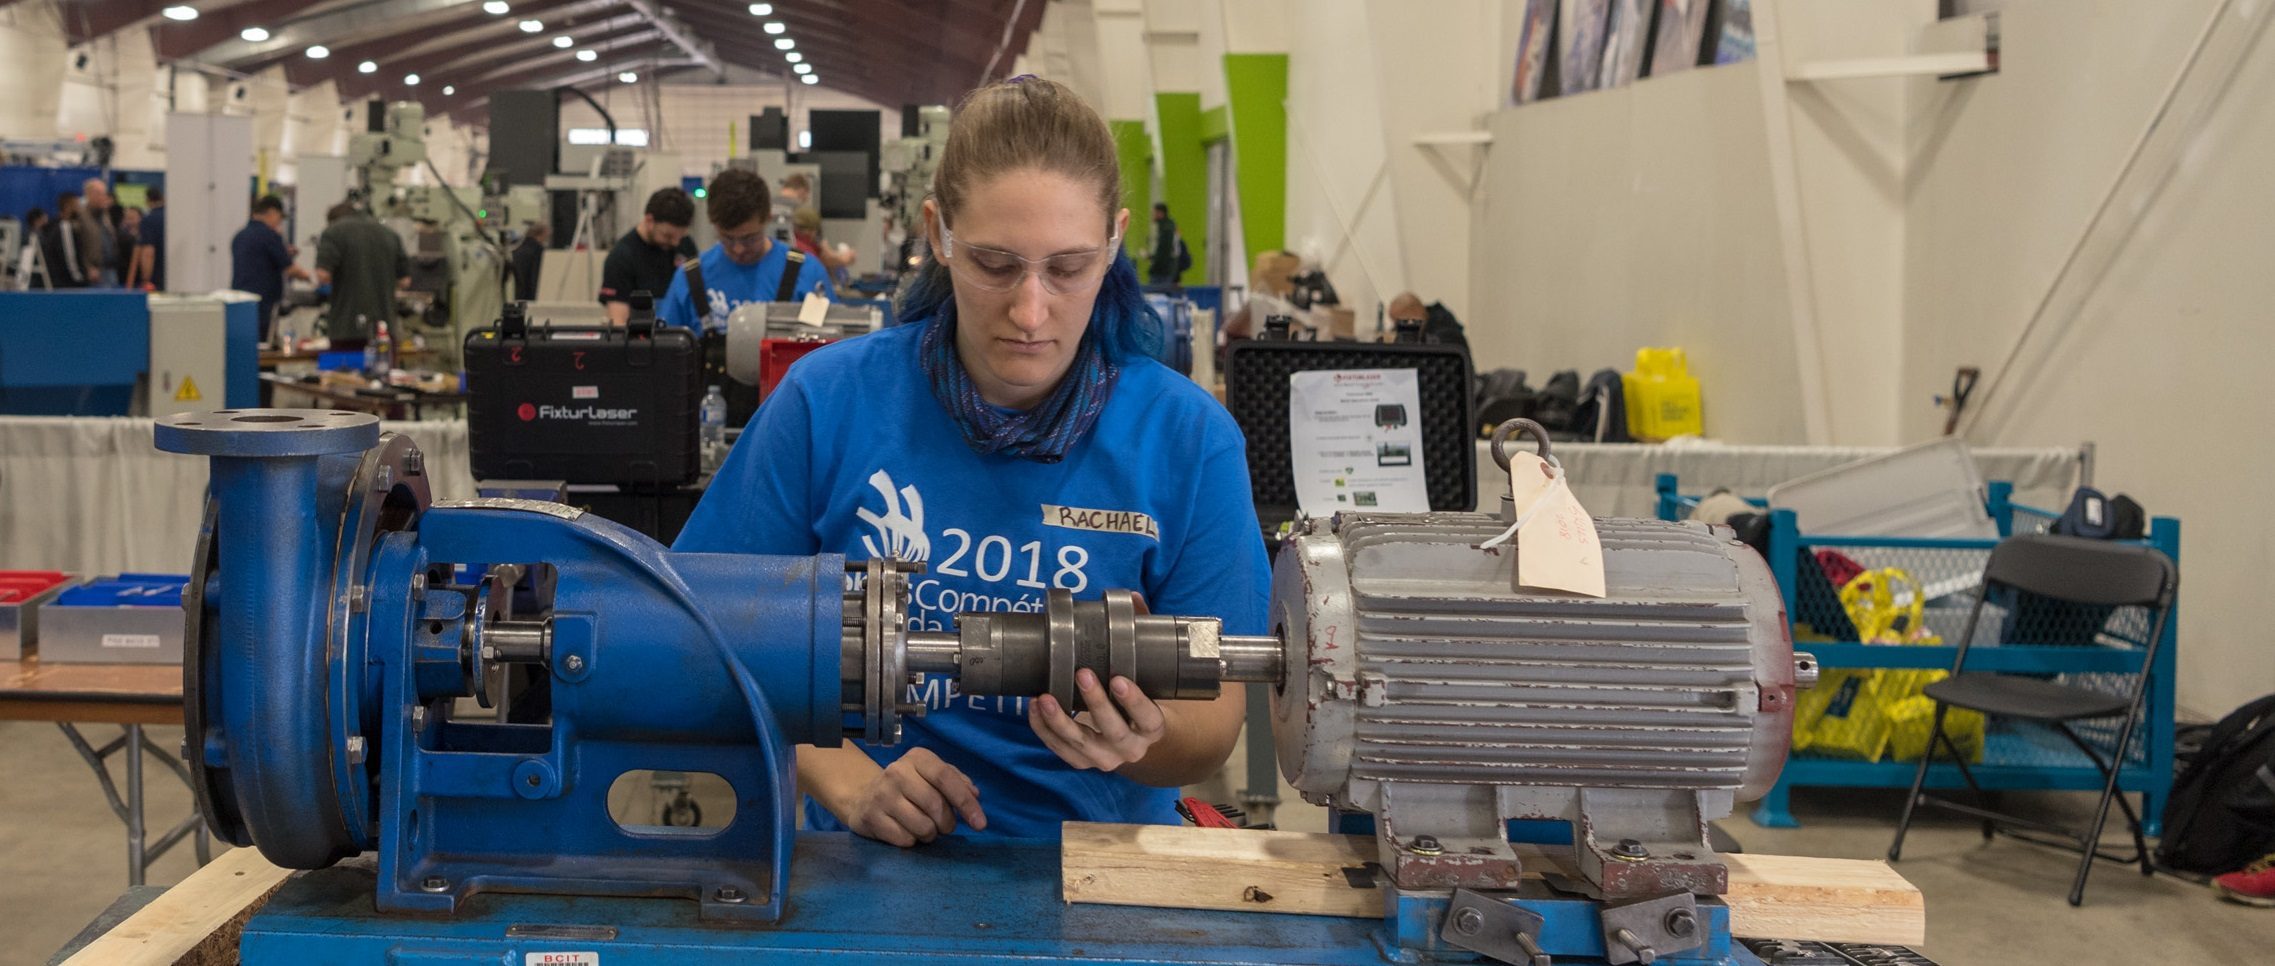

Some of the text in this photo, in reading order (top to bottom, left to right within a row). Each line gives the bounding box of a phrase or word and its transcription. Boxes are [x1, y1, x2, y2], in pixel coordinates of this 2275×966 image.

[1060, 507, 1158, 536] RACHAEL
[936, 528, 1089, 593] 2018
[544, 954, 581, 963] BCIT
